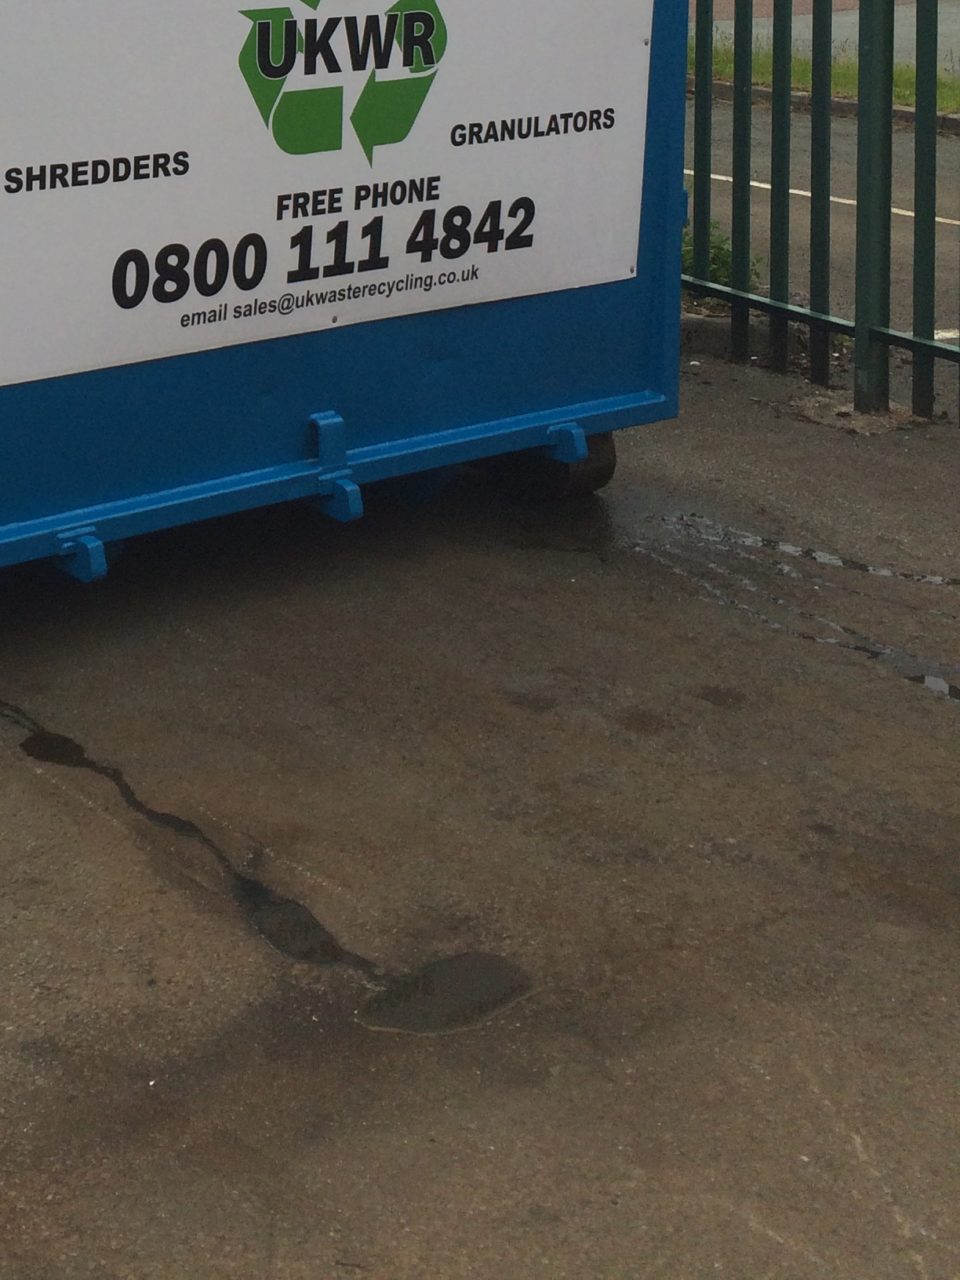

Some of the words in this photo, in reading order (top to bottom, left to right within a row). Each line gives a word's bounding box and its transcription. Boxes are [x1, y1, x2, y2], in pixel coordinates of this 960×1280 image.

[257, 11, 437, 79] UKWR
[450, 108, 615, 147] GRANULATORS
[3, 151, 190, 194] SHREDDERS
[276, 187, 343, 221] FREE
[354, 176, 441, 211] PHONE
[112, 233, 268, 309] 0800
[286, 216, 389, 284] 111
[406, 196, 536, 263] 4842
[179, 303, 228, 328] email
[233, 264, 480, 320] sales@ukwasterecycling.co.uk
